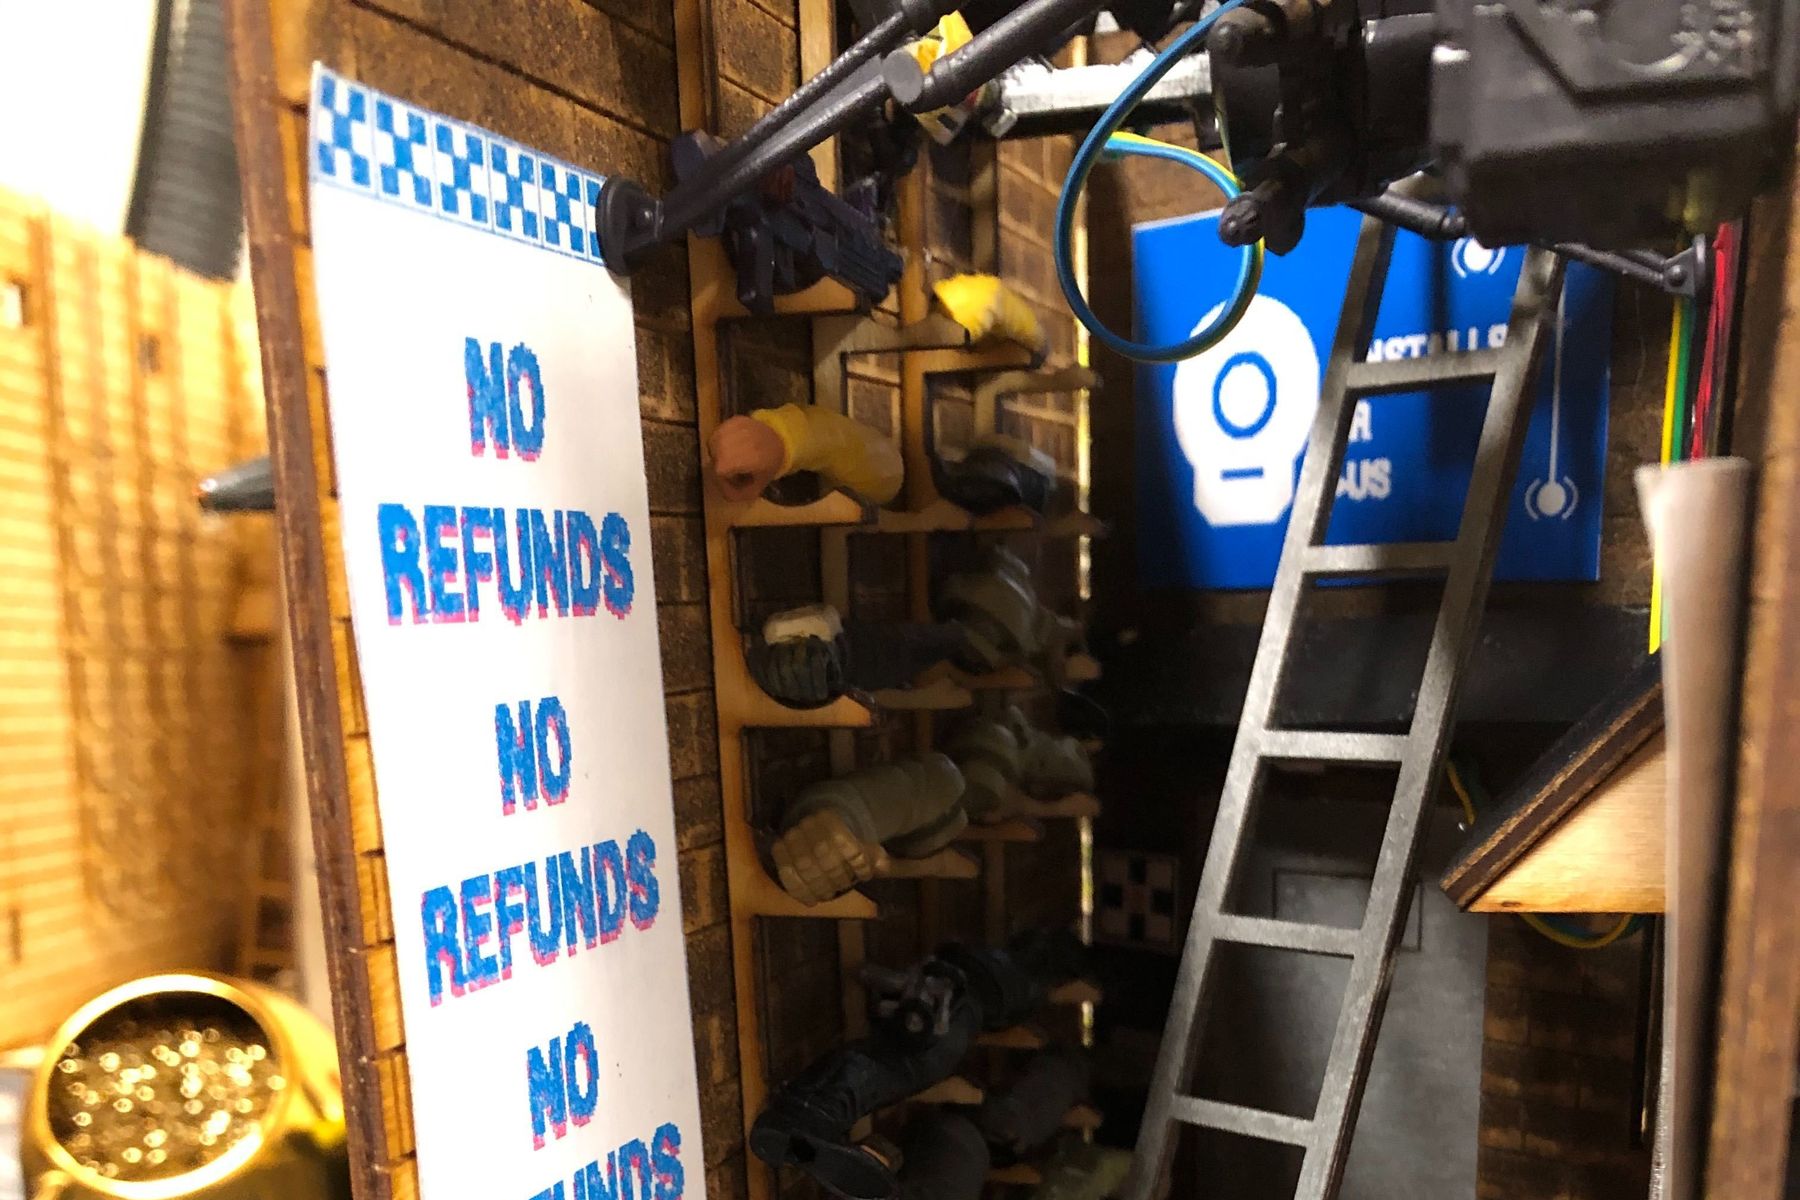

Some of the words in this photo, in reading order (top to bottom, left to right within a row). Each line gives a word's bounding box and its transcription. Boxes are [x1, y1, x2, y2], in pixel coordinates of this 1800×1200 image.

[465, 337, 545, 462] NO
[377, 502, 635, 626] REFUNDS
[495, 697, 572, 816] NO
[421, 828, 661, 1007] REFUNDS
[526, 1020, 600, 1151] NO
